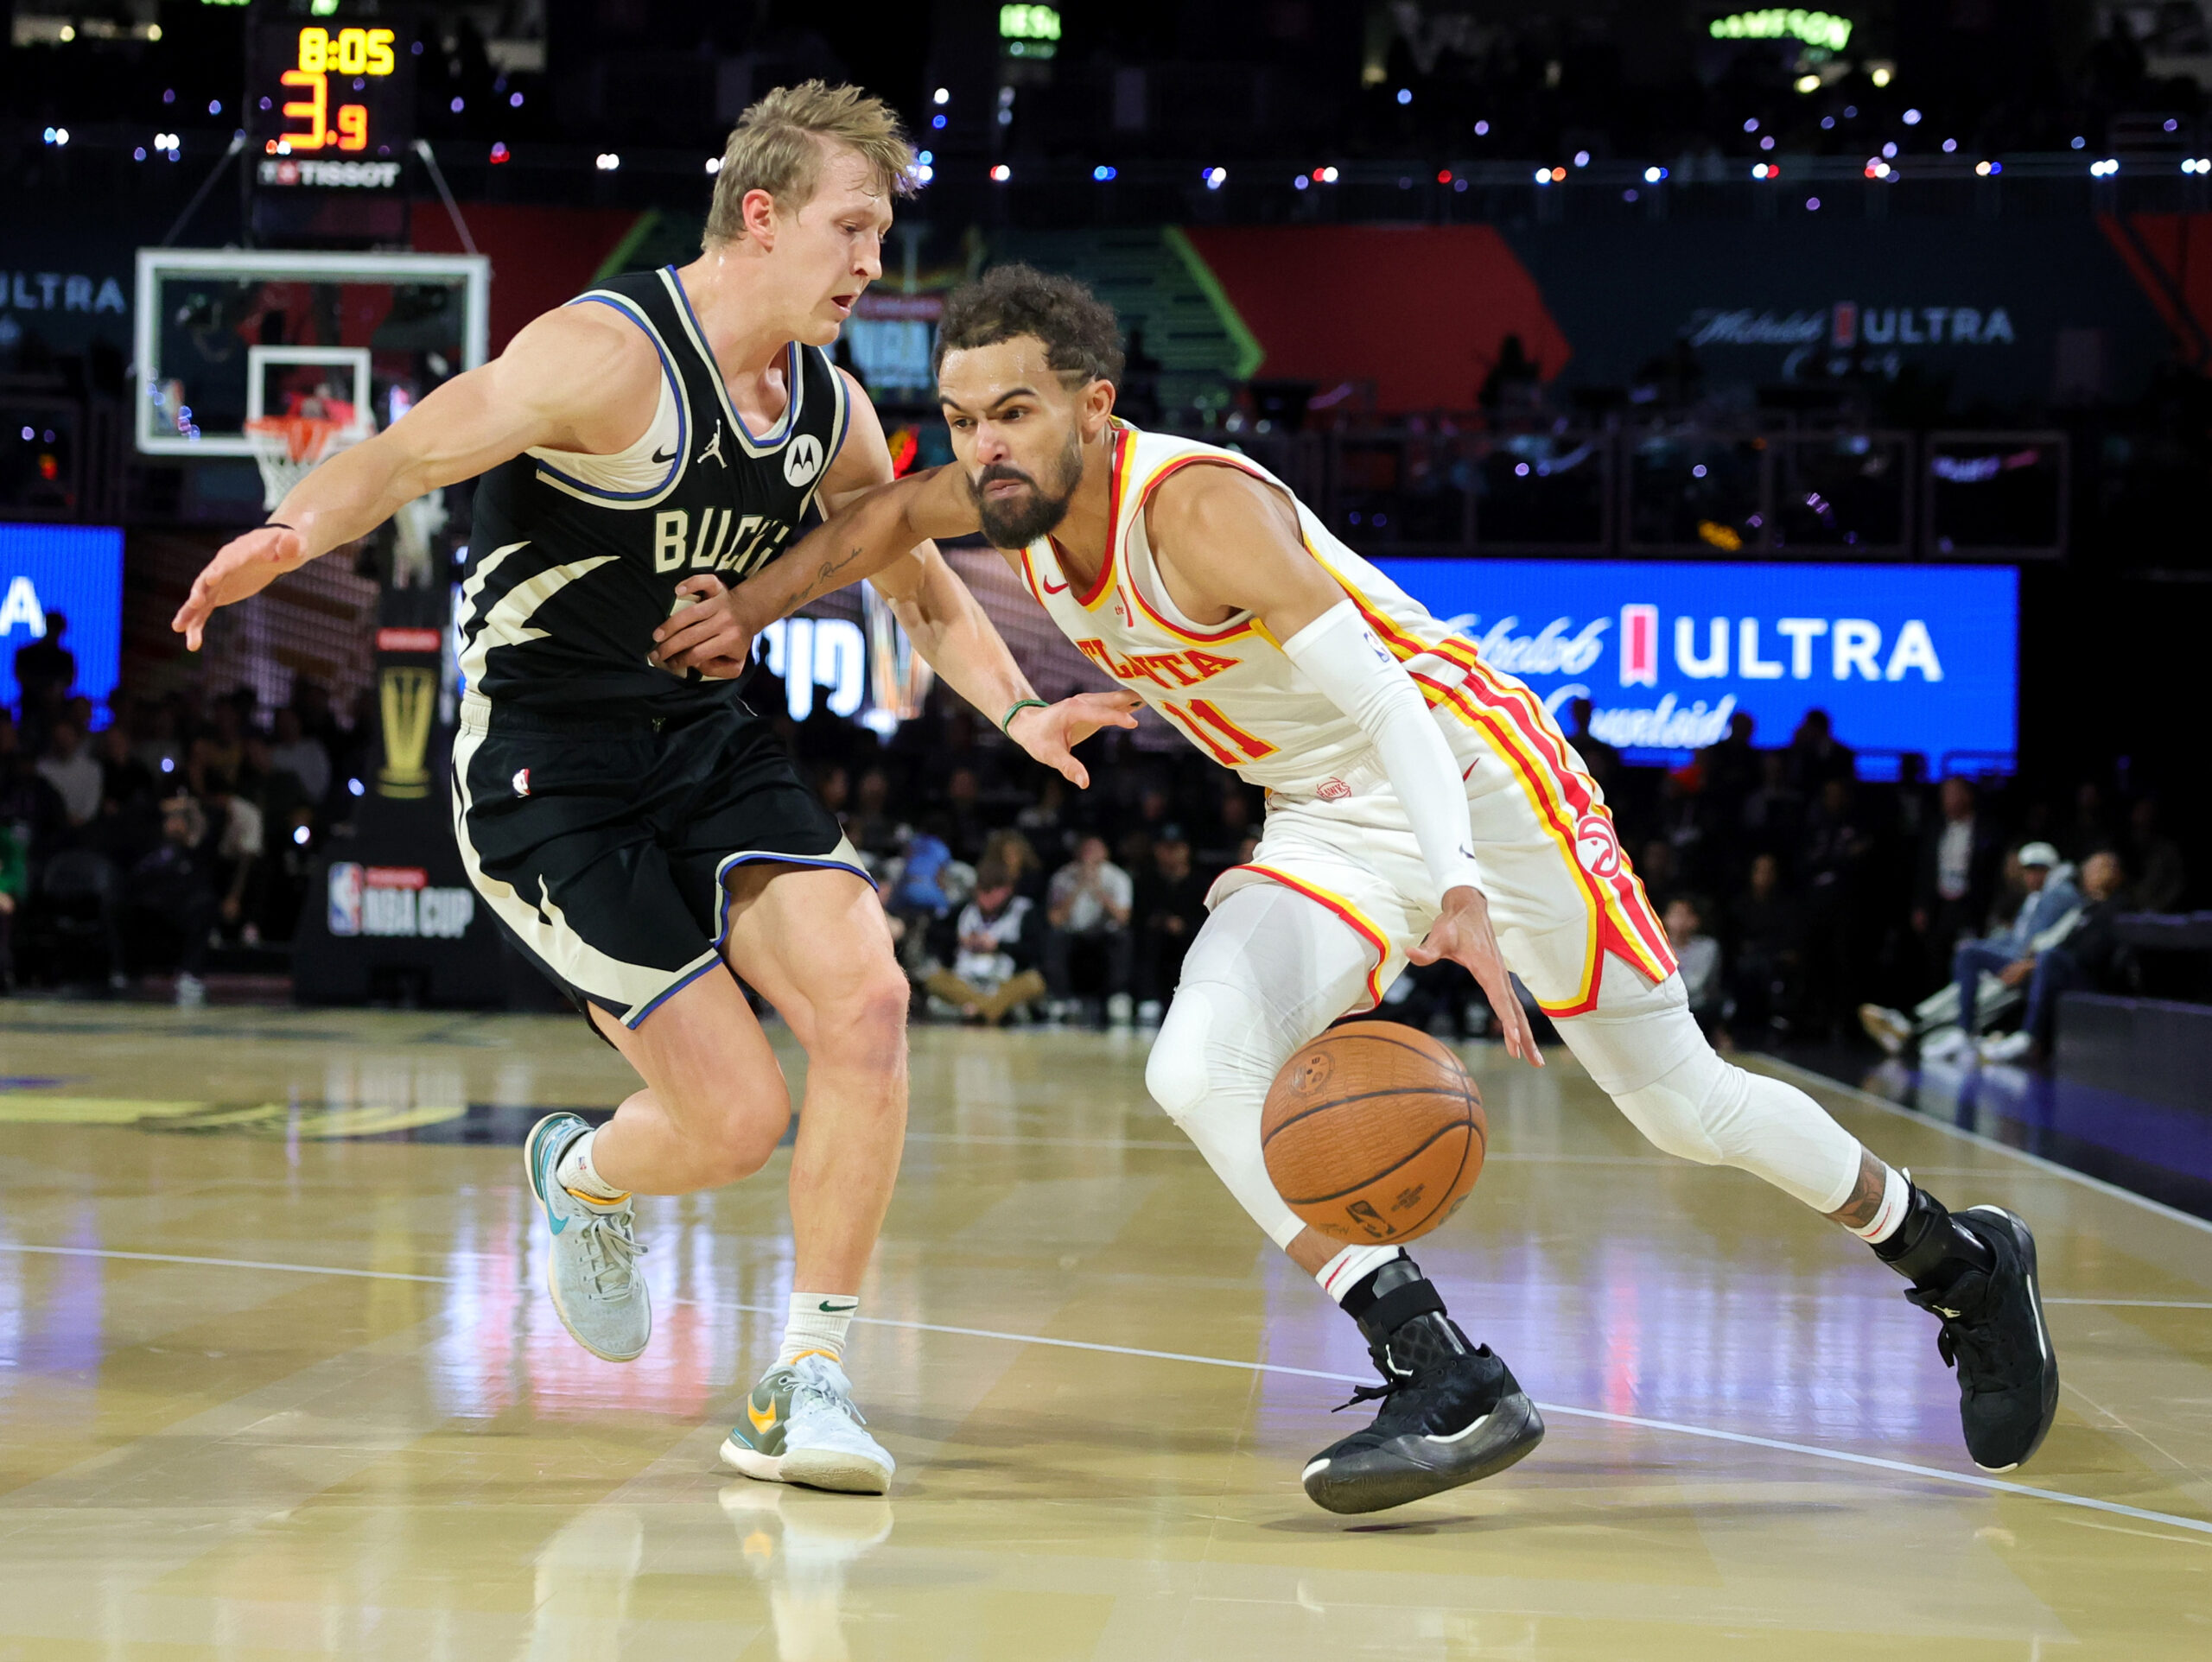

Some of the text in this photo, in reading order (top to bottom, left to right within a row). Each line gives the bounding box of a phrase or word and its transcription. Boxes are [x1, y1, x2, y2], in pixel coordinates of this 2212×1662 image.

[299, 27, 395, 75] 8:05
[279, 69, 368, 150] 3.9
[300, 160, 401, 187] TISSOT
[0, 270, 127, 314] LTRA
[1863, 307, 2014, 346] ULTRA
[655, 506, 791, 579] BUCK
[0, 575, 48, 638] A
[1674, 616, 1944, 682] ULTRA
[1158, 699, 1282, 768] 11
[1316, 782, 1351, 800] HAWKS
[419, 887, 474, 938] CUP
